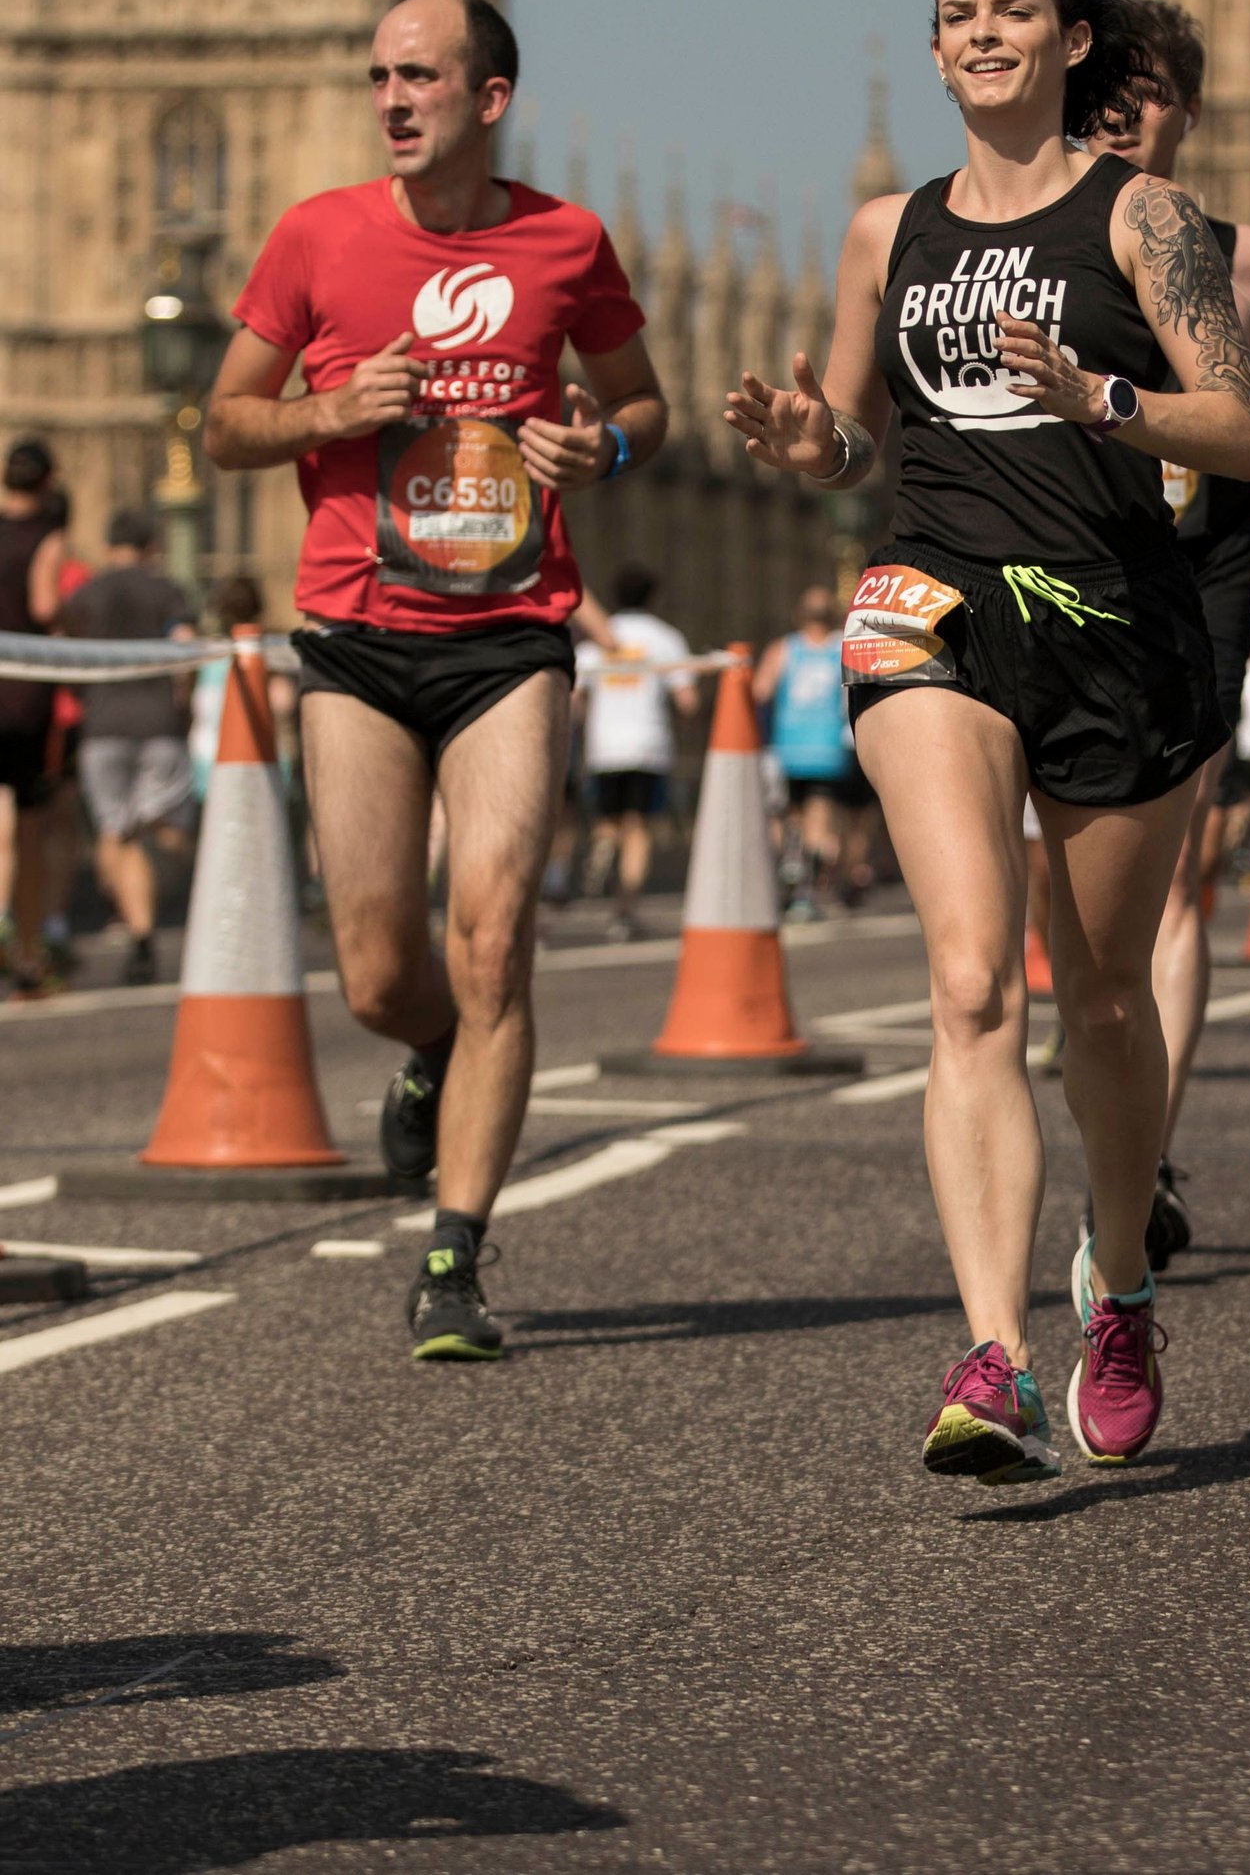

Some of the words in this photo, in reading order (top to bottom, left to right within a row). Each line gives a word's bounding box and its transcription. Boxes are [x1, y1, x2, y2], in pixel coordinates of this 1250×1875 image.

[951, 246, 1034, 282] LDN
[899, 278, 1067, 328] BRUNCH
[937, 323, 1004, 362] CLU
[428, 360, 471, 377] ESS
[477, 361, 526, 382] FOR
[419, 379, 512, 403] CCESS
[406, 475, 517, 509] C6530
[853, 574, 954, 613] C2147
[849, 640, 896, 650] WESTMINSTER
